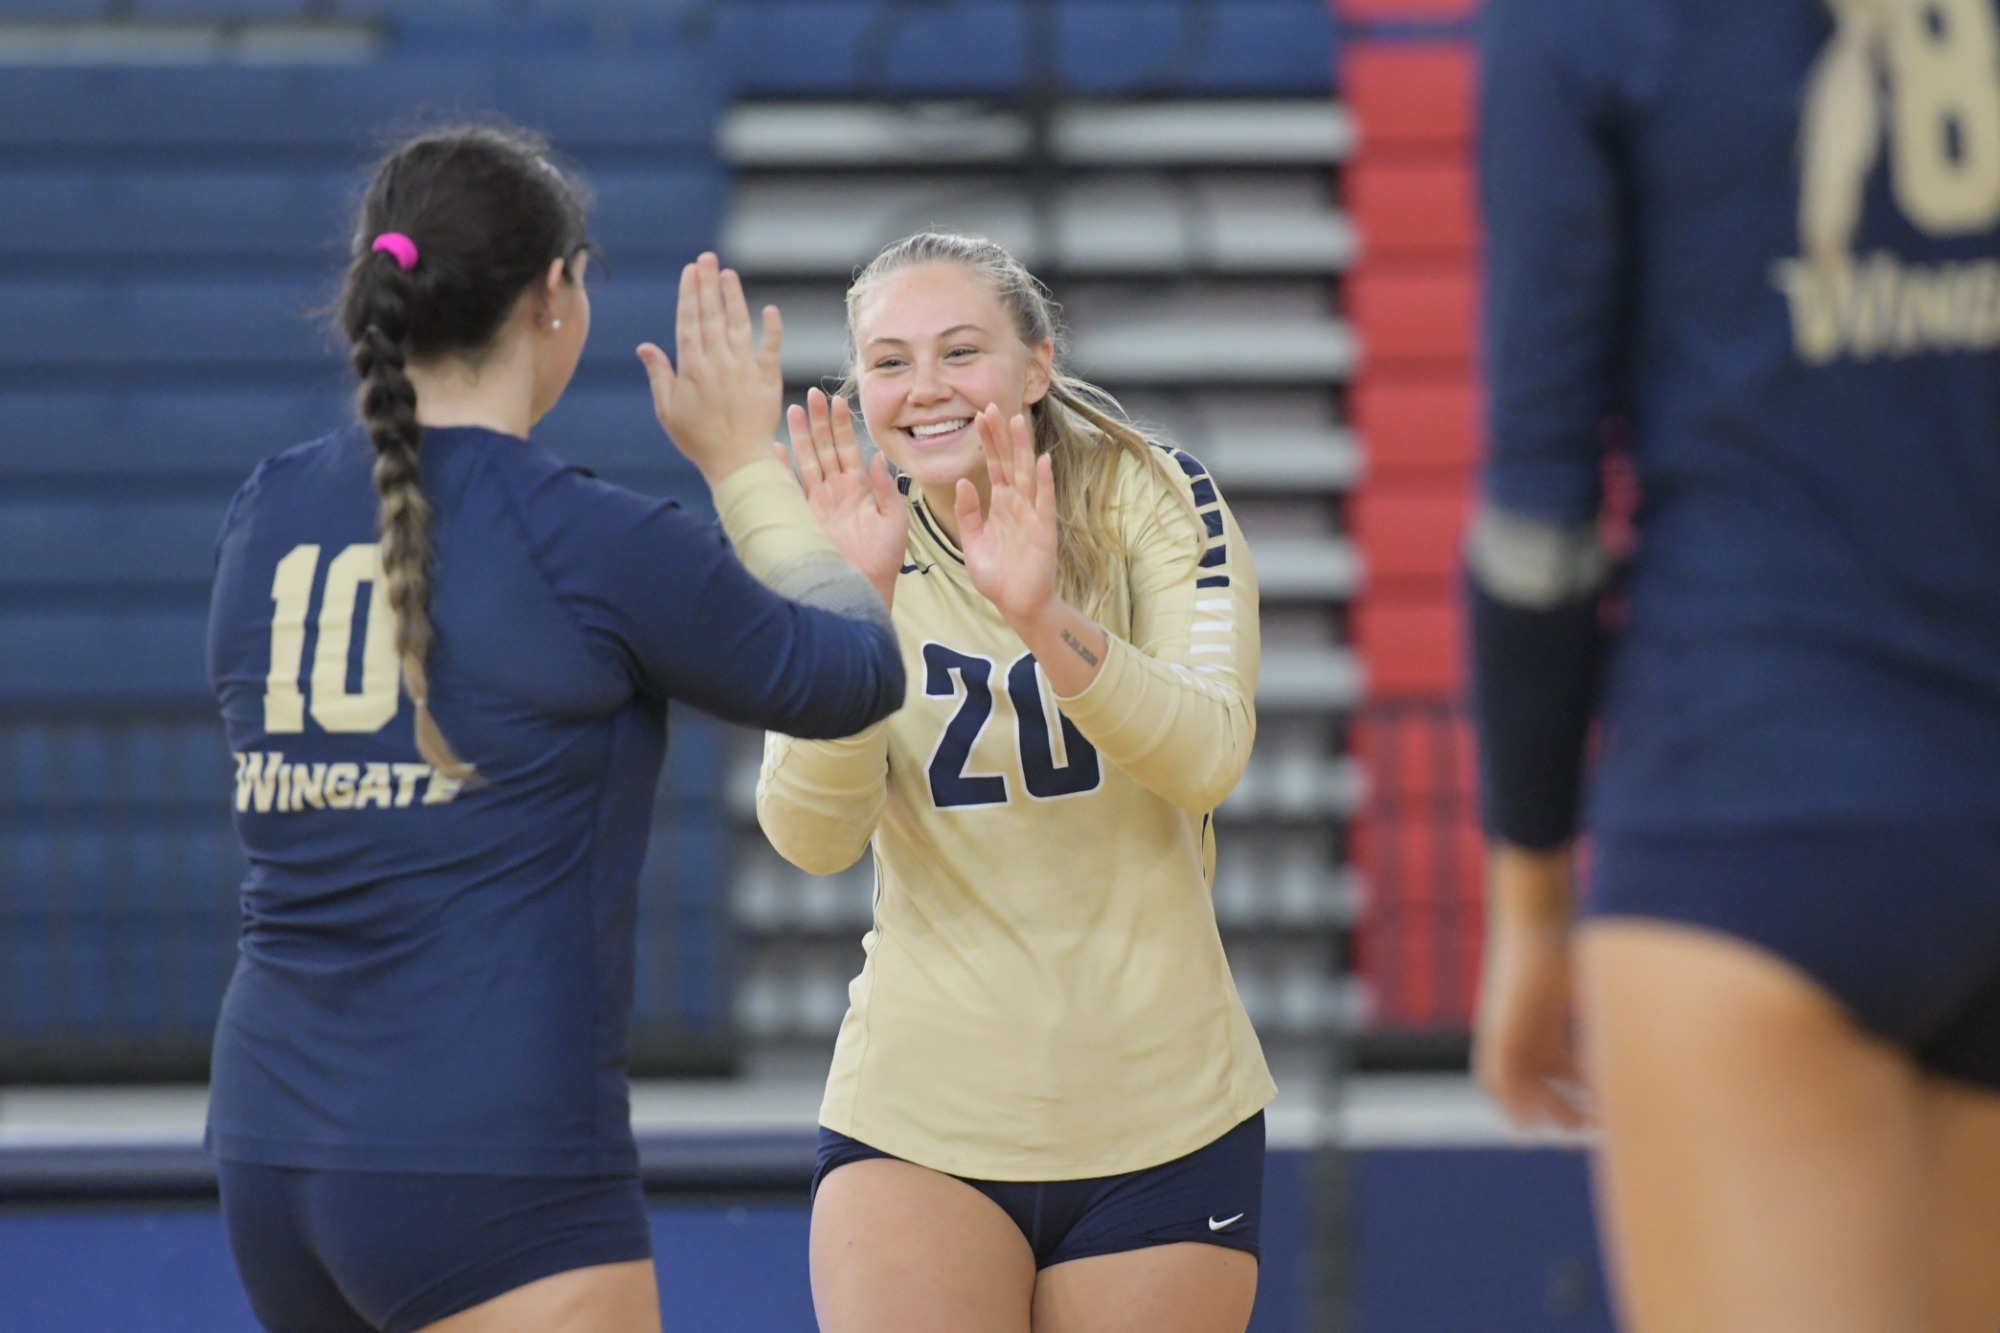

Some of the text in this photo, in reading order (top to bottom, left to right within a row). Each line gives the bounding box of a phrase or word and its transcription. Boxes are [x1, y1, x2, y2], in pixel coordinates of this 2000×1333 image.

[264, 543, 401, 733] 10
[234, 752, 476, 813] WINGATE
[921, 640, 1104, 811] 20
